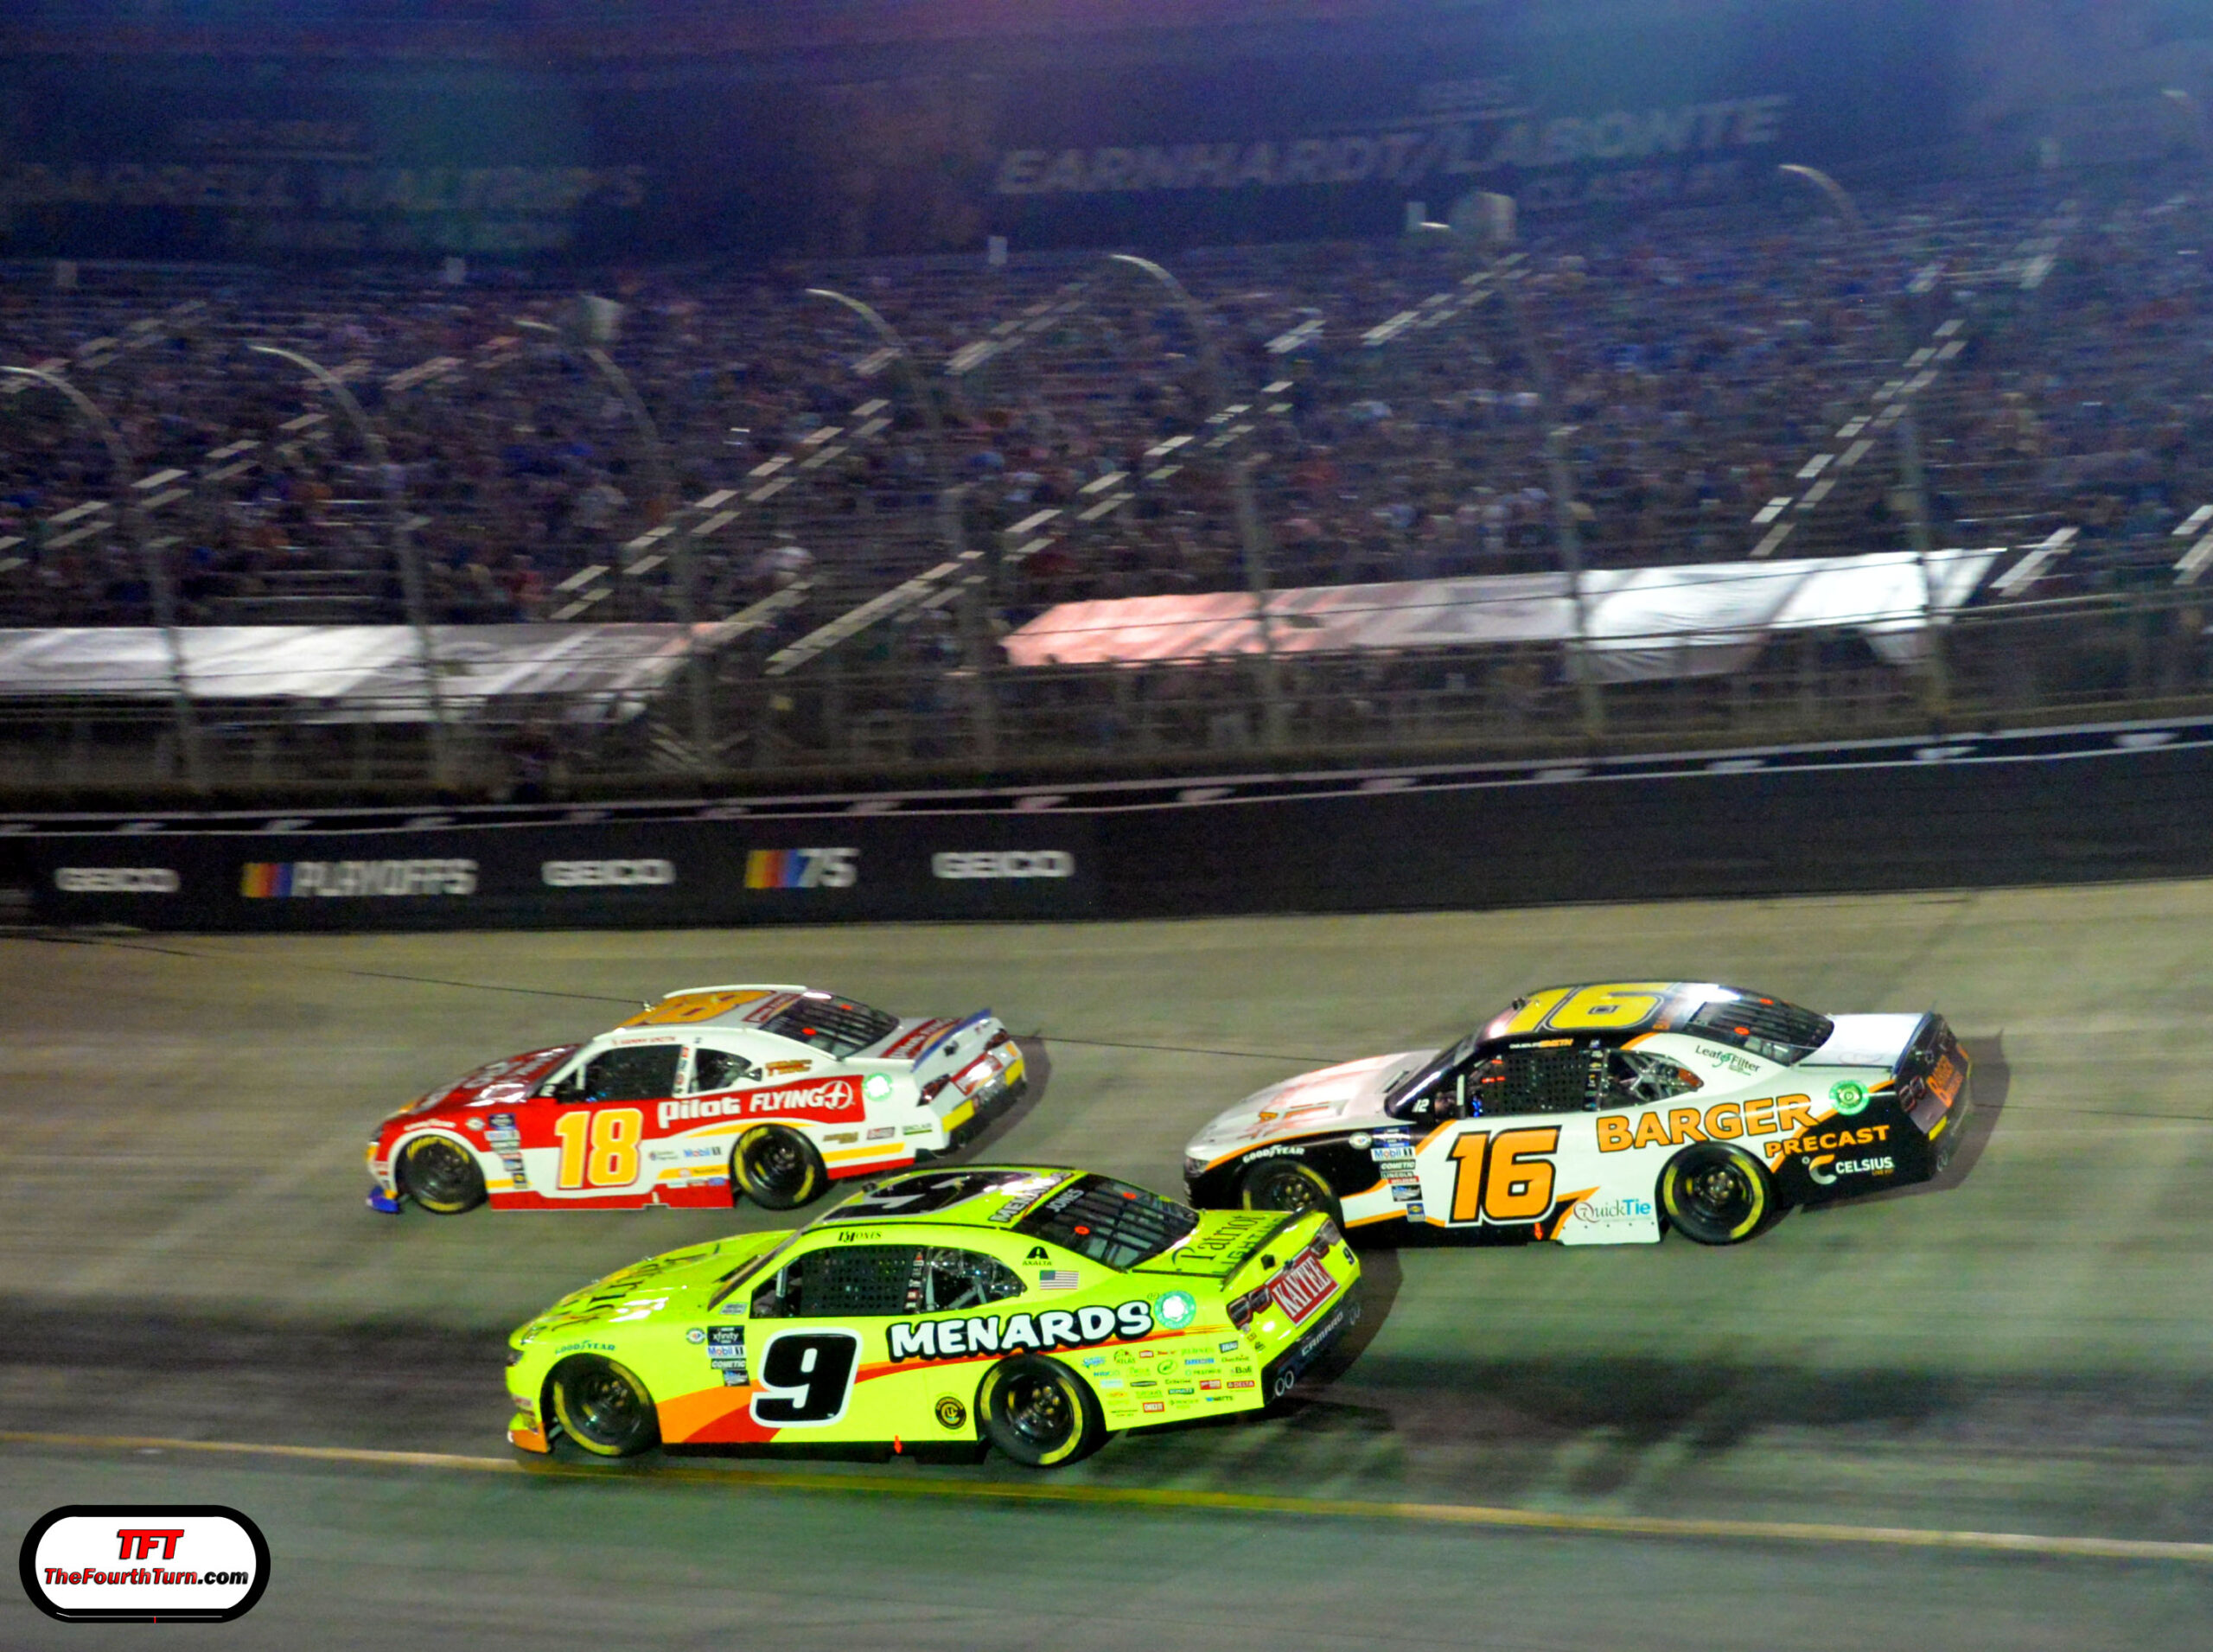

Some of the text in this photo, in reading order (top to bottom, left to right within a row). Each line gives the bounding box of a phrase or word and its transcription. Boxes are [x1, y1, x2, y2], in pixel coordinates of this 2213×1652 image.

[292, 859, 478, 896] PLAYOFFS
[932, 851, 1075, 878] GEICO
[749, 1088, 825, 1113] FLYING
[1412, 1099, 1430, 1113] 12
[1597, 1094, 1821, 1152] BARGER
[554, 1107, 643, 1190] 18
[1242, 1144, 1305, 1164] GOODYEAR
[1374, 1148, 1402, 1159] Mobil
[1763, 1125, 1890, 1158] PRECAST
[1445, 1125, 1562, 1224] 16
[1835, 1156, 1894, 1174] CELSIUS
[1272, 1255, 1332, 1317] KAYTEE
[713, 1331, 739, 1343] xfinity
[887, 1299, 1155, 1362] MENARDS
[1301, 1311, 1343, 1356] CAMARO
[555, 1340, 615, 1355] GOODYEAR
[708, 1346, 733, 1356] Mobil
[749, 1327, 864, 1428] 9
